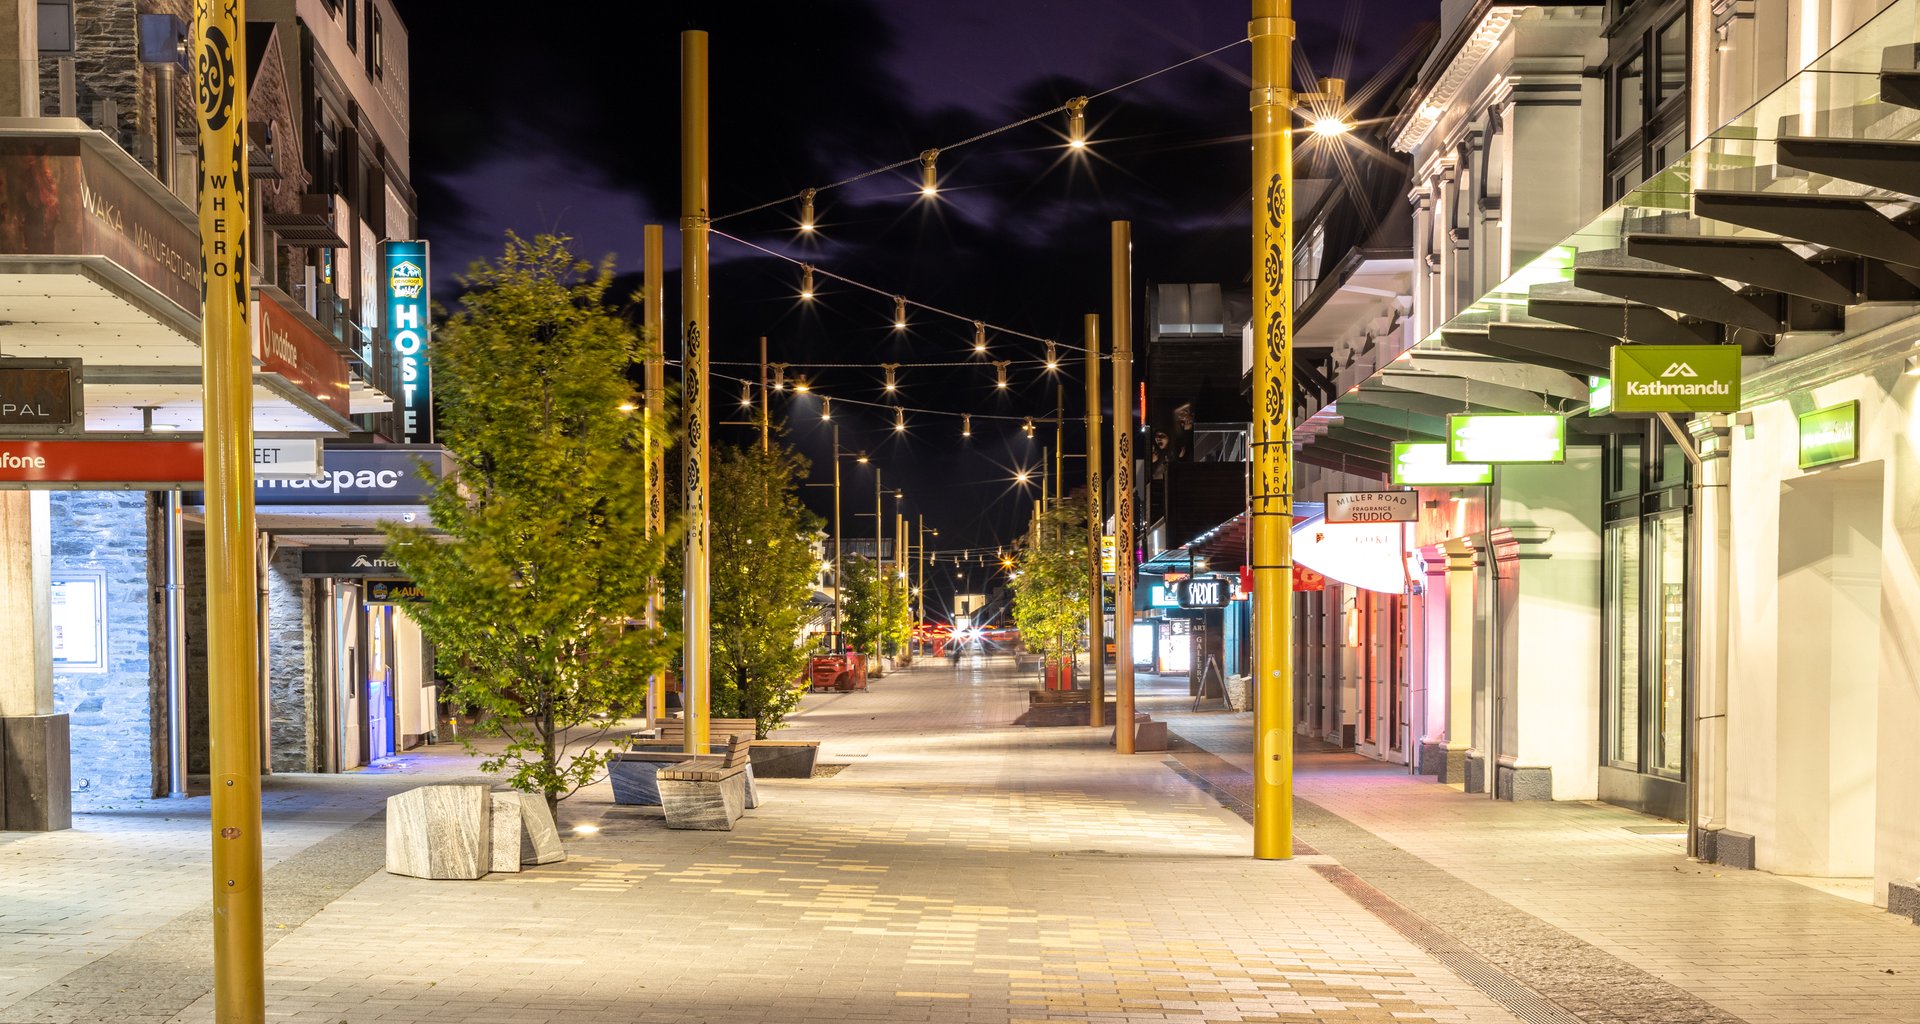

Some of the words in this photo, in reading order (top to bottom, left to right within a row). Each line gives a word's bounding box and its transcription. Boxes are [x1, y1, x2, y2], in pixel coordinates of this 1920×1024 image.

[80, 182, 124, 236] WAKA
[210, 175, 228, 277] WHERO
[271, 328, 298, 369] vodafone
[1626, 380, 1729, 396] Kathmandu
[2, 403, 50, 416] PAL
[0, 452, 46, 469] fone
[1271, 445, 1281, 494] WHERO
[1336, 493, 1373, 507] MILLER
[1377, 493, 1407, 506] ROAD
[1352, 512, 1393, 521] STUDIO
[398, 586, 425, 597] AUN
